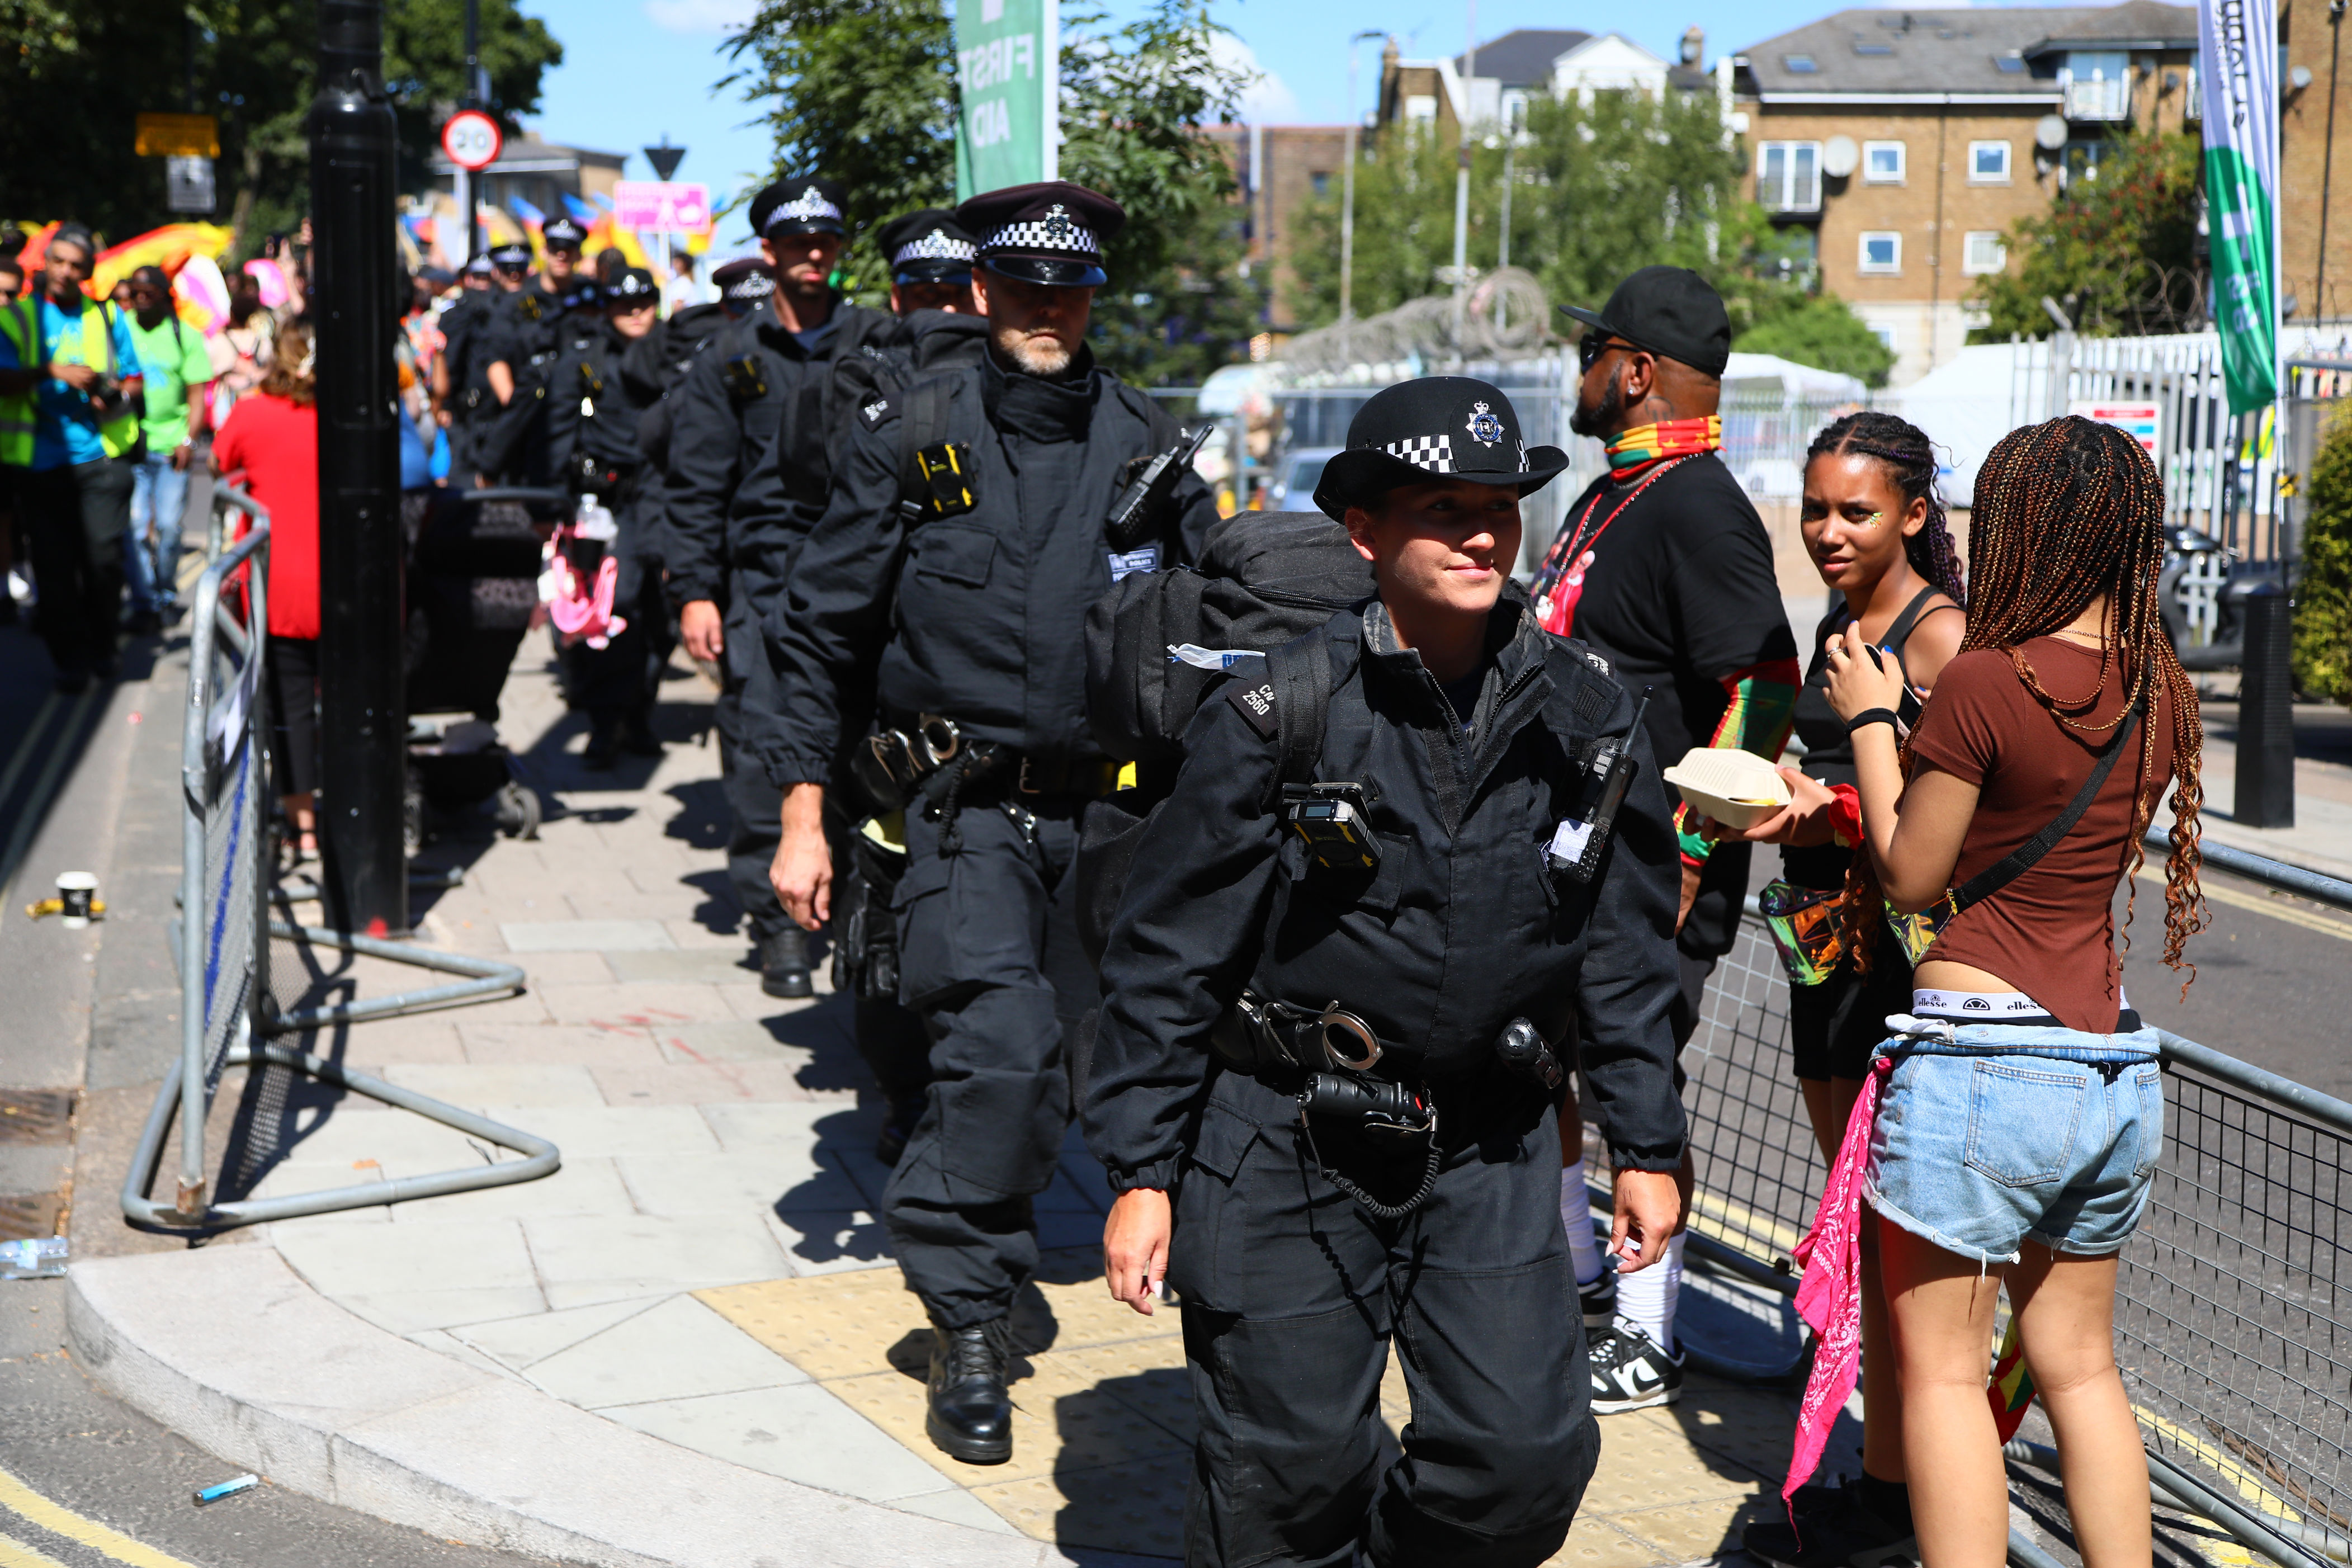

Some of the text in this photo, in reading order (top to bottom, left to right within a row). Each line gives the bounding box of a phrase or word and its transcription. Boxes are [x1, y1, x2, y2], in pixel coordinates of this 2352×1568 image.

[454, 129, 490, 152] 20
[1128, 558, 1151, 567] POLICE
[1259, 684, 1275, 702] CN
[1242, 690, 1270, 716] 2560
[1919, 998, 1947, 1008] ellesse
[2006, 1001, 2044, 1010] elles
